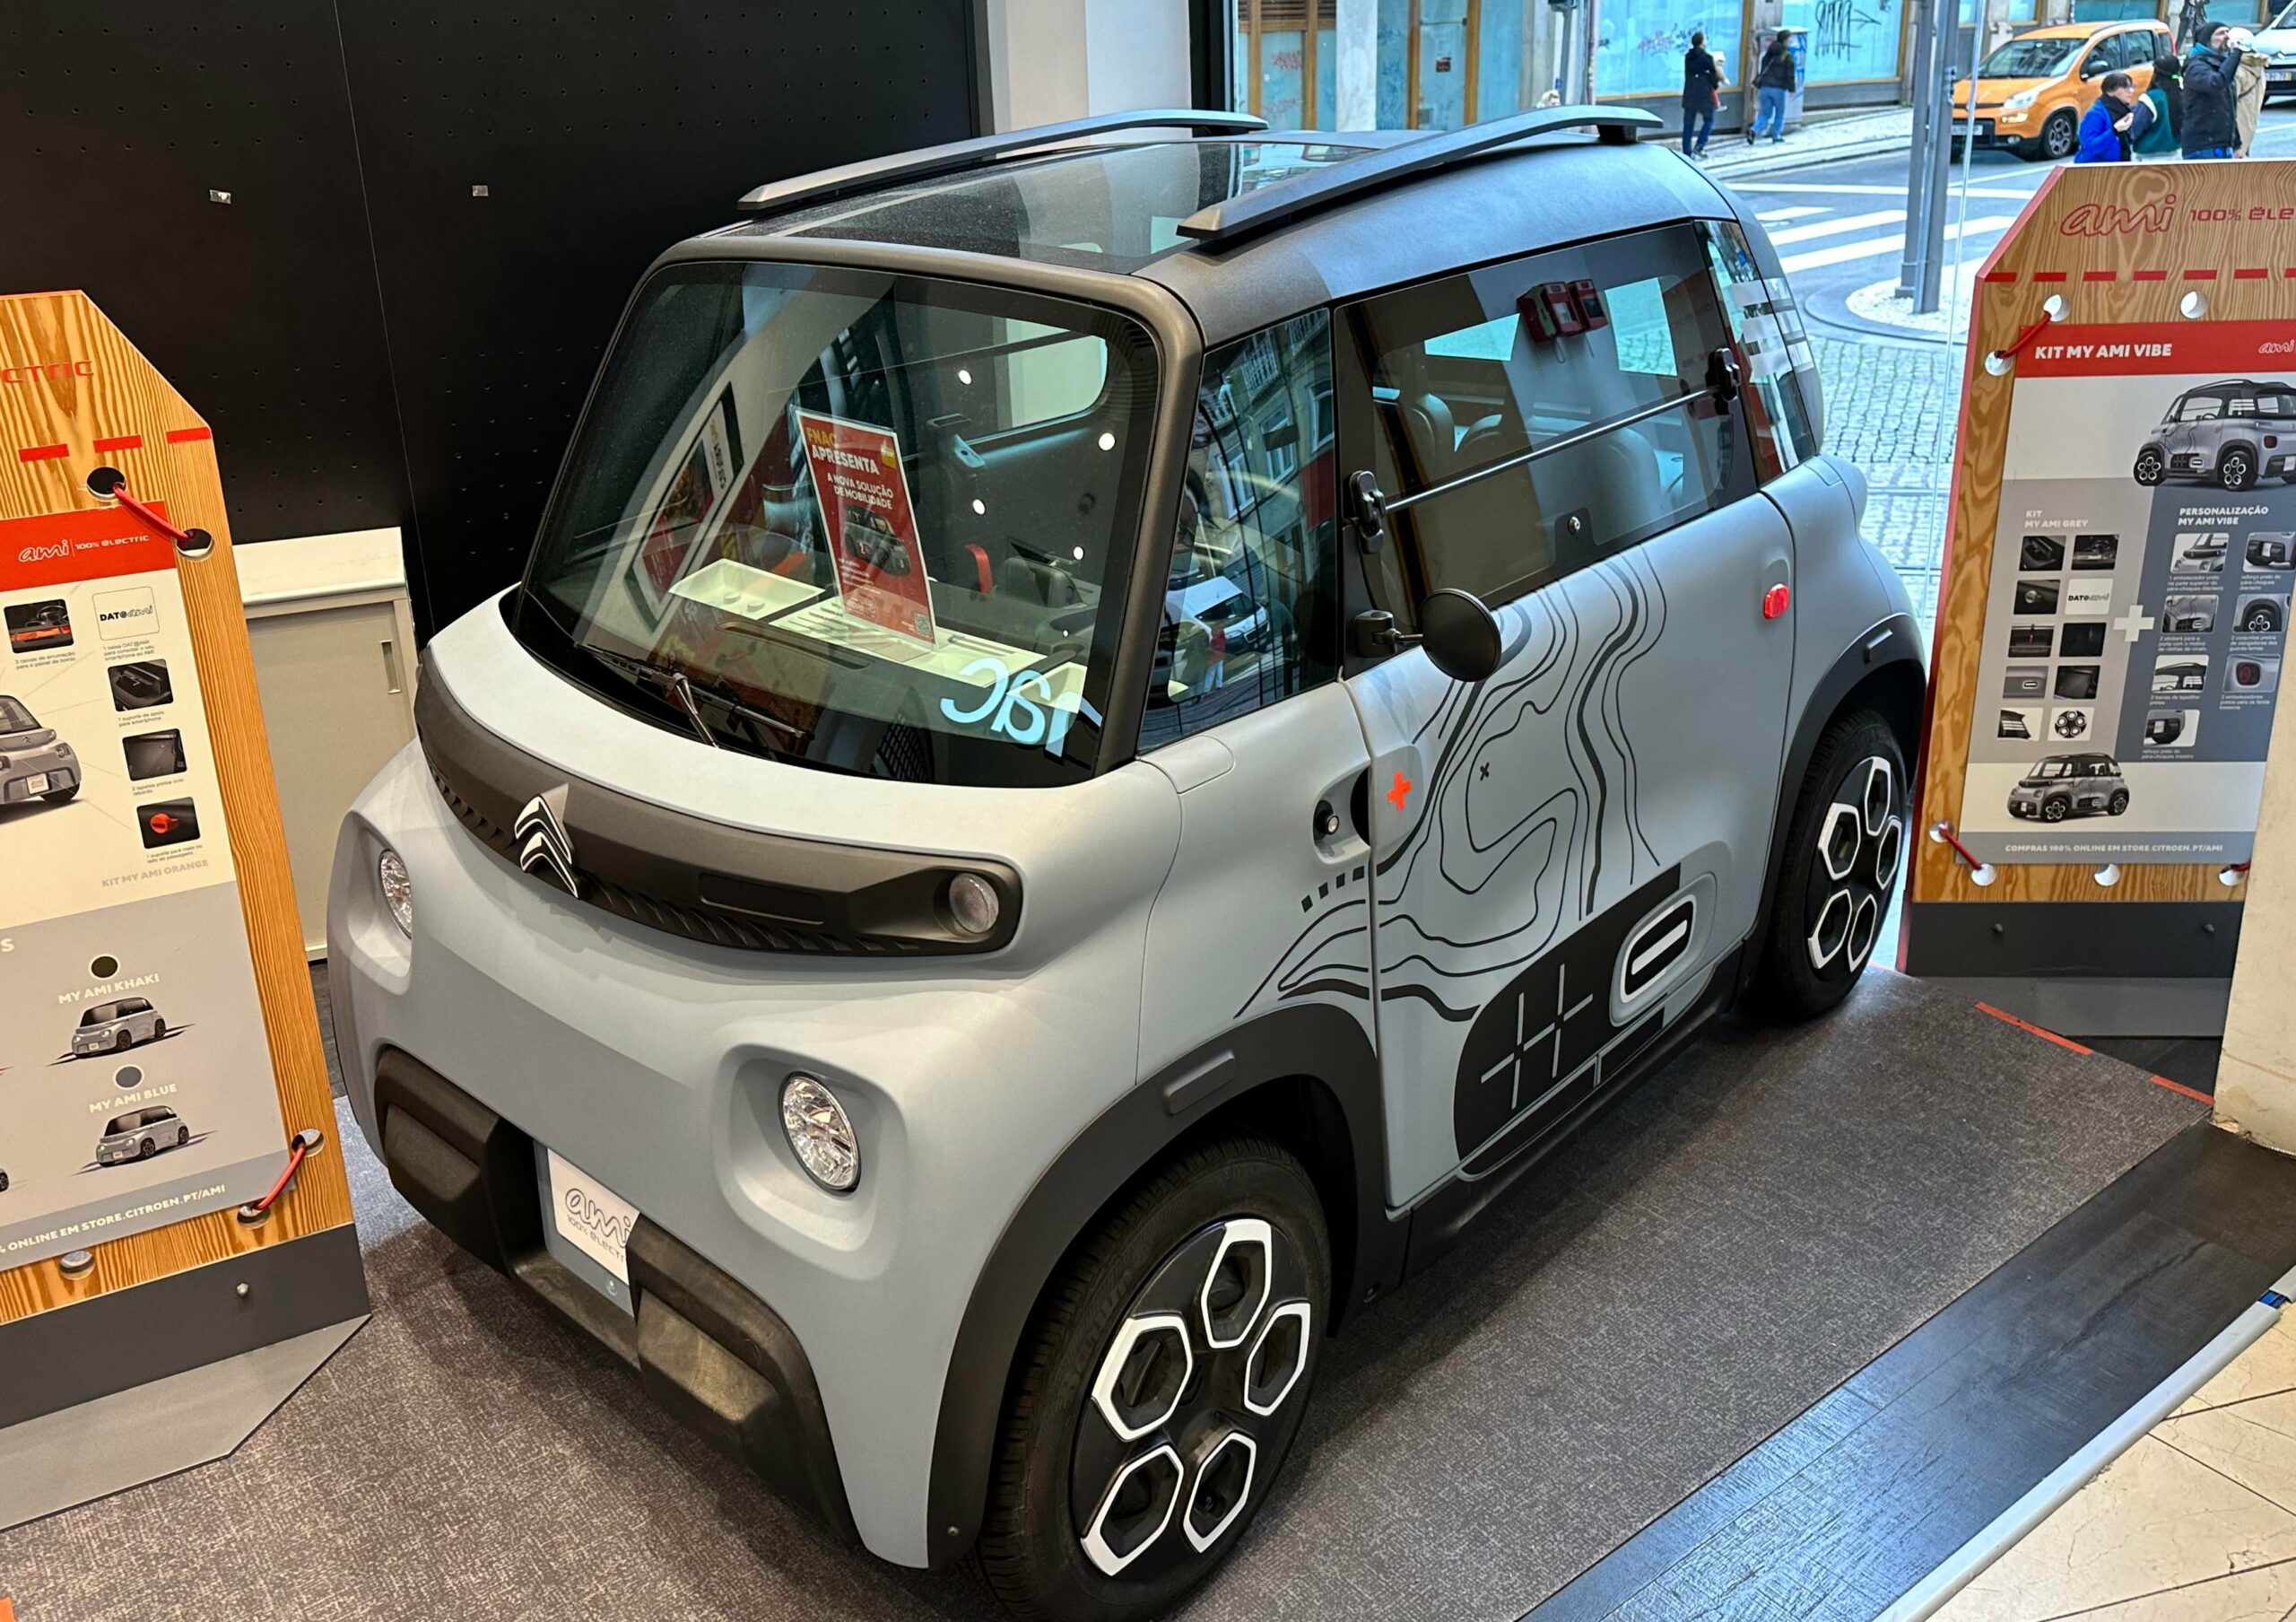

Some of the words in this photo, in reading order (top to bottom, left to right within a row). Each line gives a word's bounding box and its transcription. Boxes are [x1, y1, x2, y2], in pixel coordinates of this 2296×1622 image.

[2060, 194, 2177, 237] ami
[2190, 208, 2241, 222] 100%
[2035, 346, 2064, 359] KIT
[2066, 345, 2092, 359] MY
[2096, 344, 2130, 358] AMI
[2134, 344, 2172, 357] VIBE
[2257, 339, 2294, 354] ami
[812, 444, 880, 475] APRESENTA
[827, 472, 833, 483] A
[833, 474, 856, 488] NOVA
[856, 479, 893, 499] SOLUÇÃO
[833, 485, 845, 496] DE
[845, 489, 892, 510] MOBILIDADE
[2026, 510, 2043, 518] KIT
[2062, 519, 2089, 528] GREY
[2178, 518, 2194, 526] MY
[2195, 517, 2214, 526] AMI
[2217, 517, 2239, 525] VIBE
[2179, 505, 2269, 516] PERSONALIZAÇÃO
[18, 538, 70, 562] ami
[75, 542, 100, 550] 100%
[101, 876, 120, 887] KIT
[122, 873, 138, 884] MY
[141, 868, 162, 880] AMI
[163, 859, 209, 875] ORANGE
[57, 990, 80, 1005] MY
[84, 983, 113, 998] AMI
[114, 973, 161, 992] KHAKI
[89, 1099, 111, 1113] MY
[114, 1092, 142, 1107] AMI
[144, 1083, 178, 1100] BLUE
[564, 1187, 631, 1249] ami
[7, 1230, 58, 1251] ONLINE
[59, 1224, 79, 1237] EM
